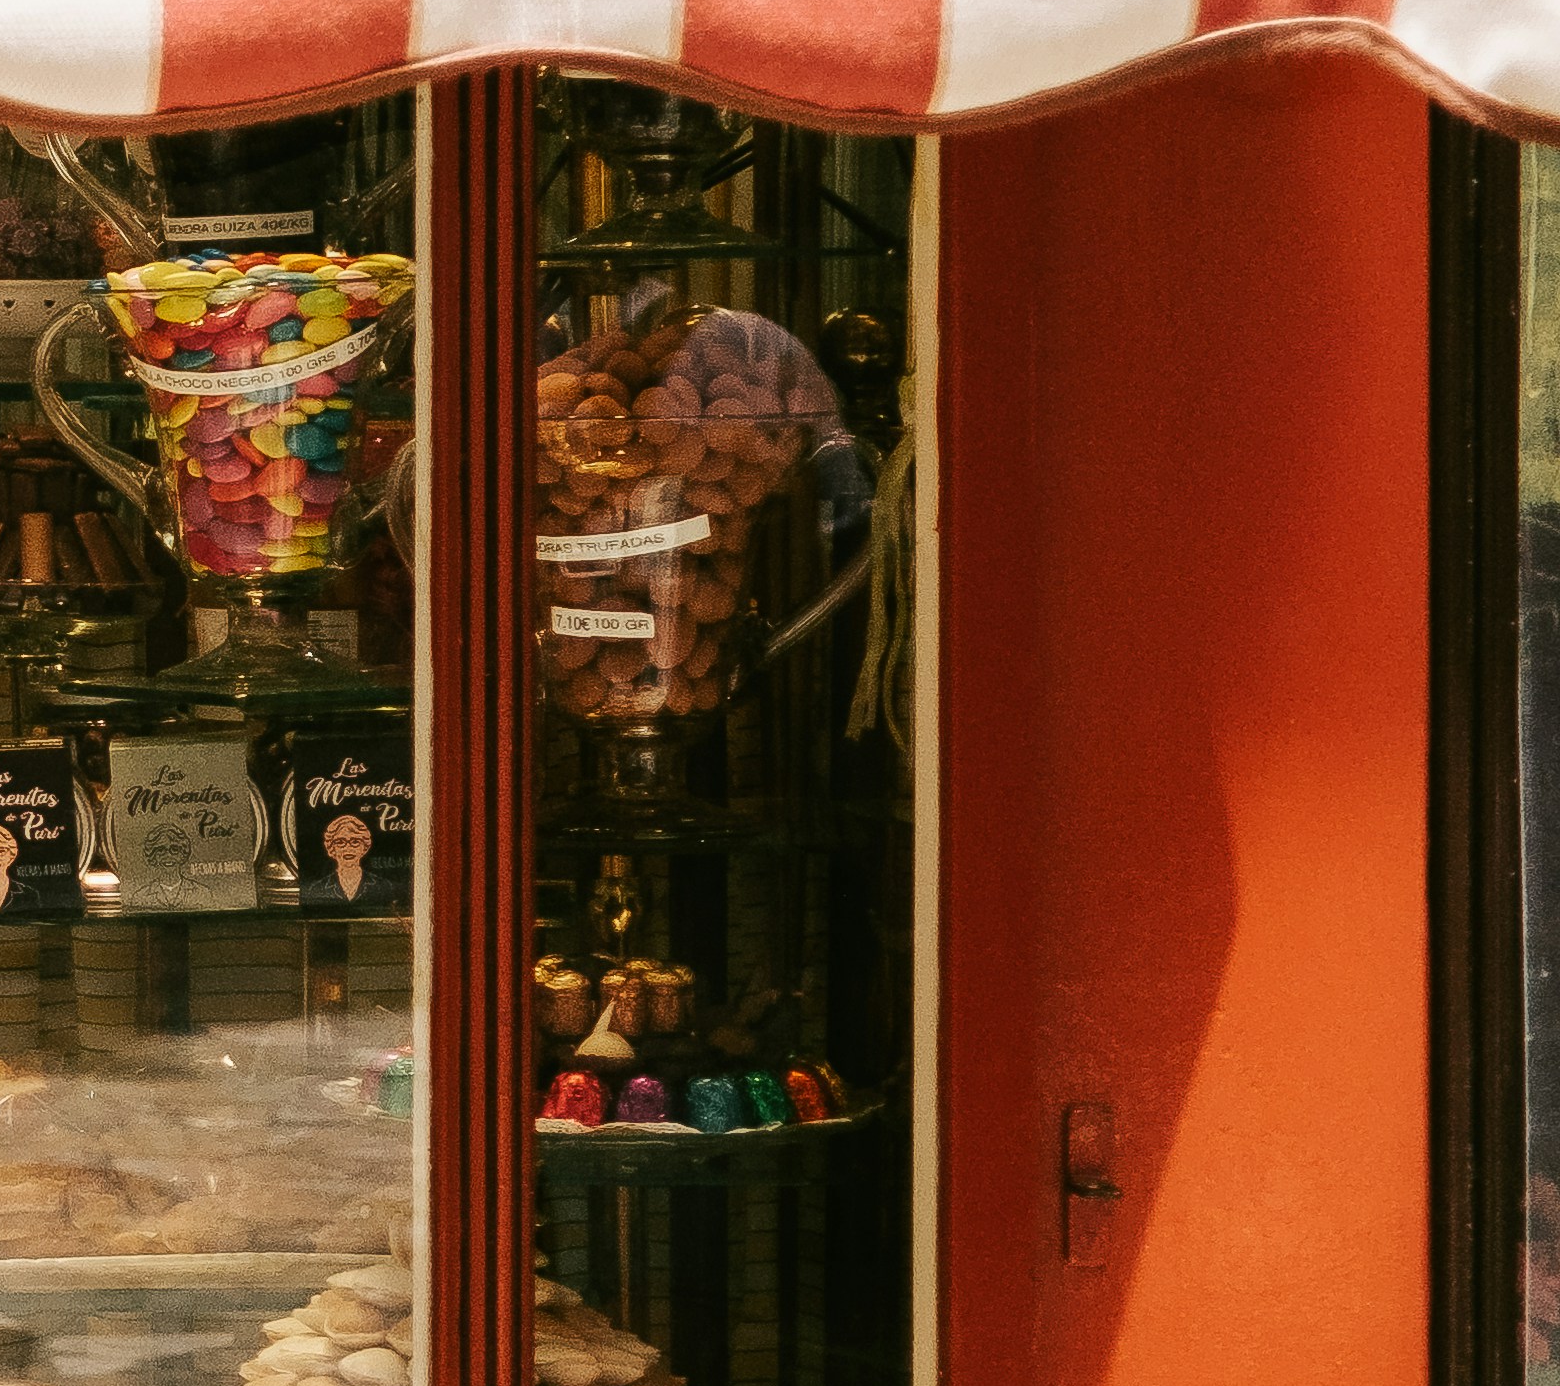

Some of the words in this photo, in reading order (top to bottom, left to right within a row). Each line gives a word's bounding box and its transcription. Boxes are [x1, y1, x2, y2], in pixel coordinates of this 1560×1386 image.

[217, 372, 274, 389] NEGRO
[279, 364, 304, 380] 100
[577, 532, 665, 552] TRUFADAS
[594, 618, 620, 630] 100
[151, 764, 186, 787] Las
[332, 758, 368, 779] Las
[124, 783, 234, 817] Morenitas
[305, 777, 414, 808] Morenitas
